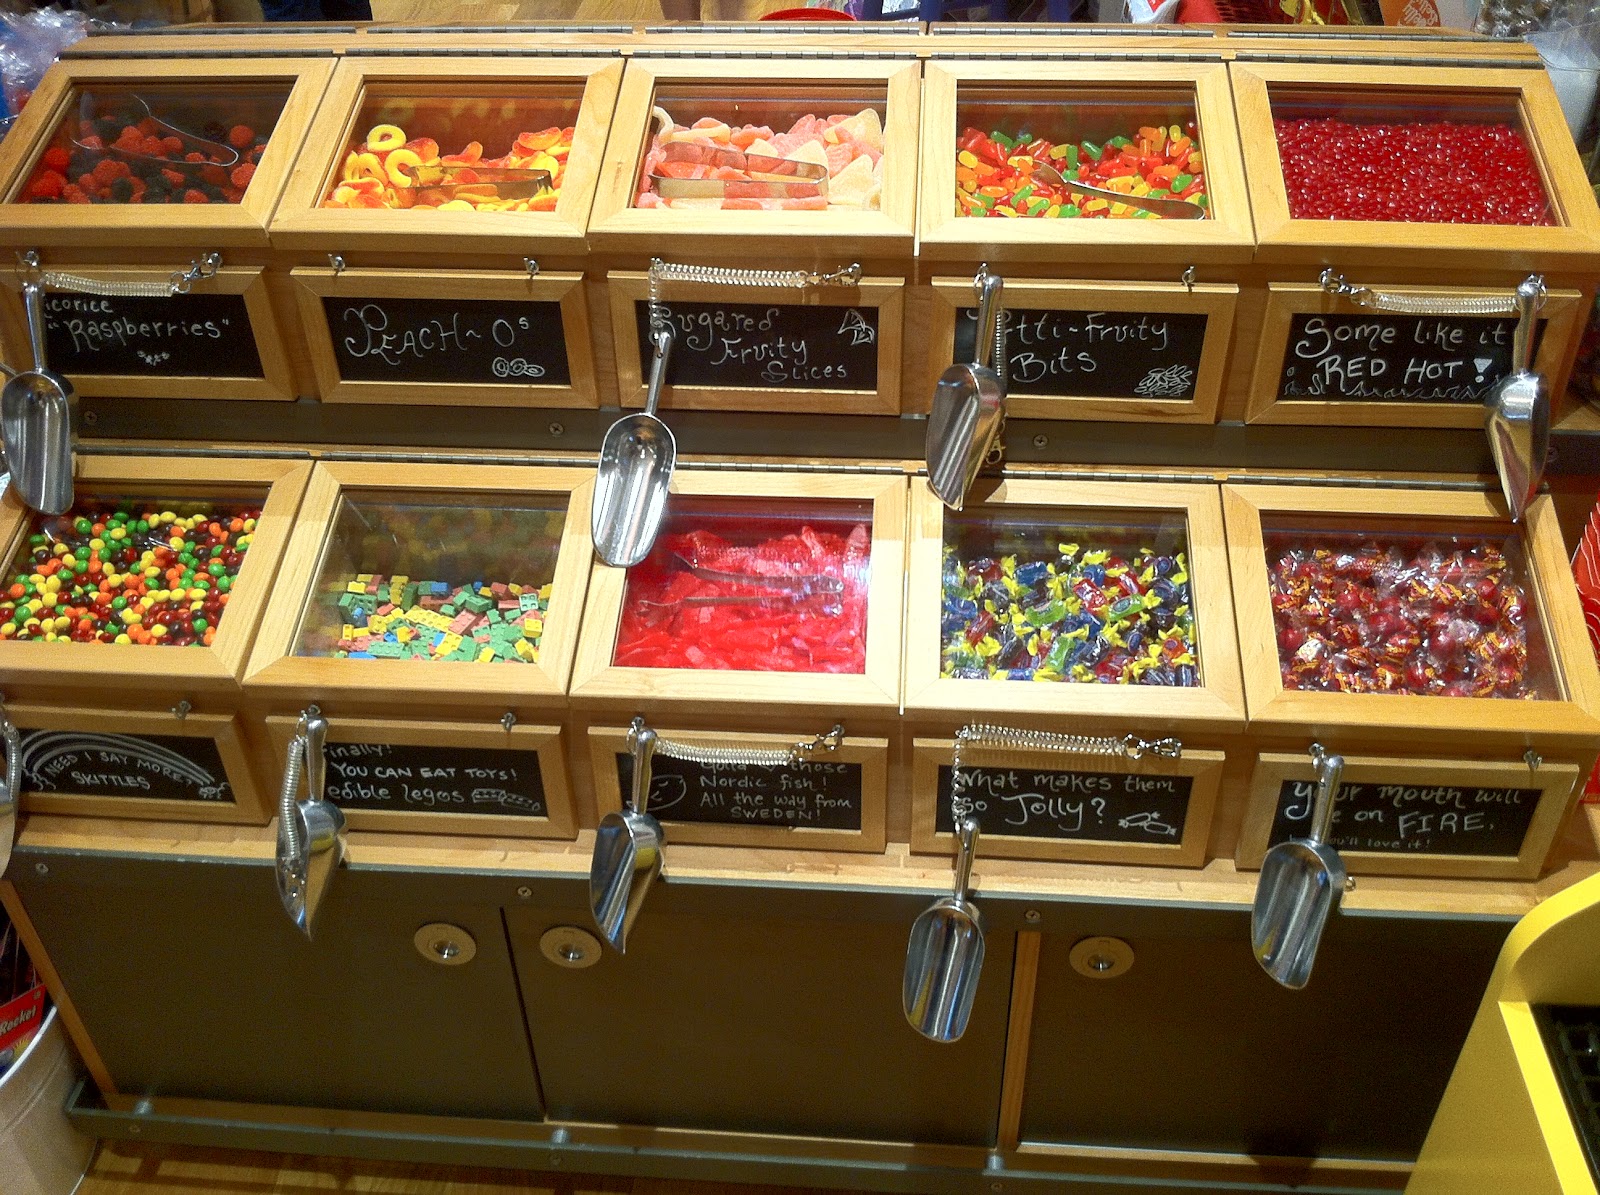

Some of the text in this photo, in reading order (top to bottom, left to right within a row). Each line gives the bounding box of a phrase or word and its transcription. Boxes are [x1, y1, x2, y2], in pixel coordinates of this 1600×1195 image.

[45, 299, 114, 319] icorice
[1295, 318, 1506, 358] Some like it
[711, 337, 807, 365] Fruity
[1010, 347, 1097, 383] Bits
[1317, 354, 1386, 392] RED
[323, 743, 393, 757] inally!
[44, 754, 78, 778] NEED
[99, 752, 128, 765] SAY
[331, 762, 368, 778] YOU
[375, 767, 412, 779] CAN
[420, 767, 456, 779] EAT
[790, 760, 848, 773] those
[71, 771, 150, 790] SKITTLES
[700, 775, 767, 789] Nordic
[958, 769, 1175, 797] What makes them
[327, 781, 464, 806] edible legos
[701, 791, 852, 809] All the way from
[1378, 784, 1466, 809] mouth
[1475, 788, 1521, 804] will
[1354, 809, 1383, 822] on
[1367, 838, 1400, 849] love
